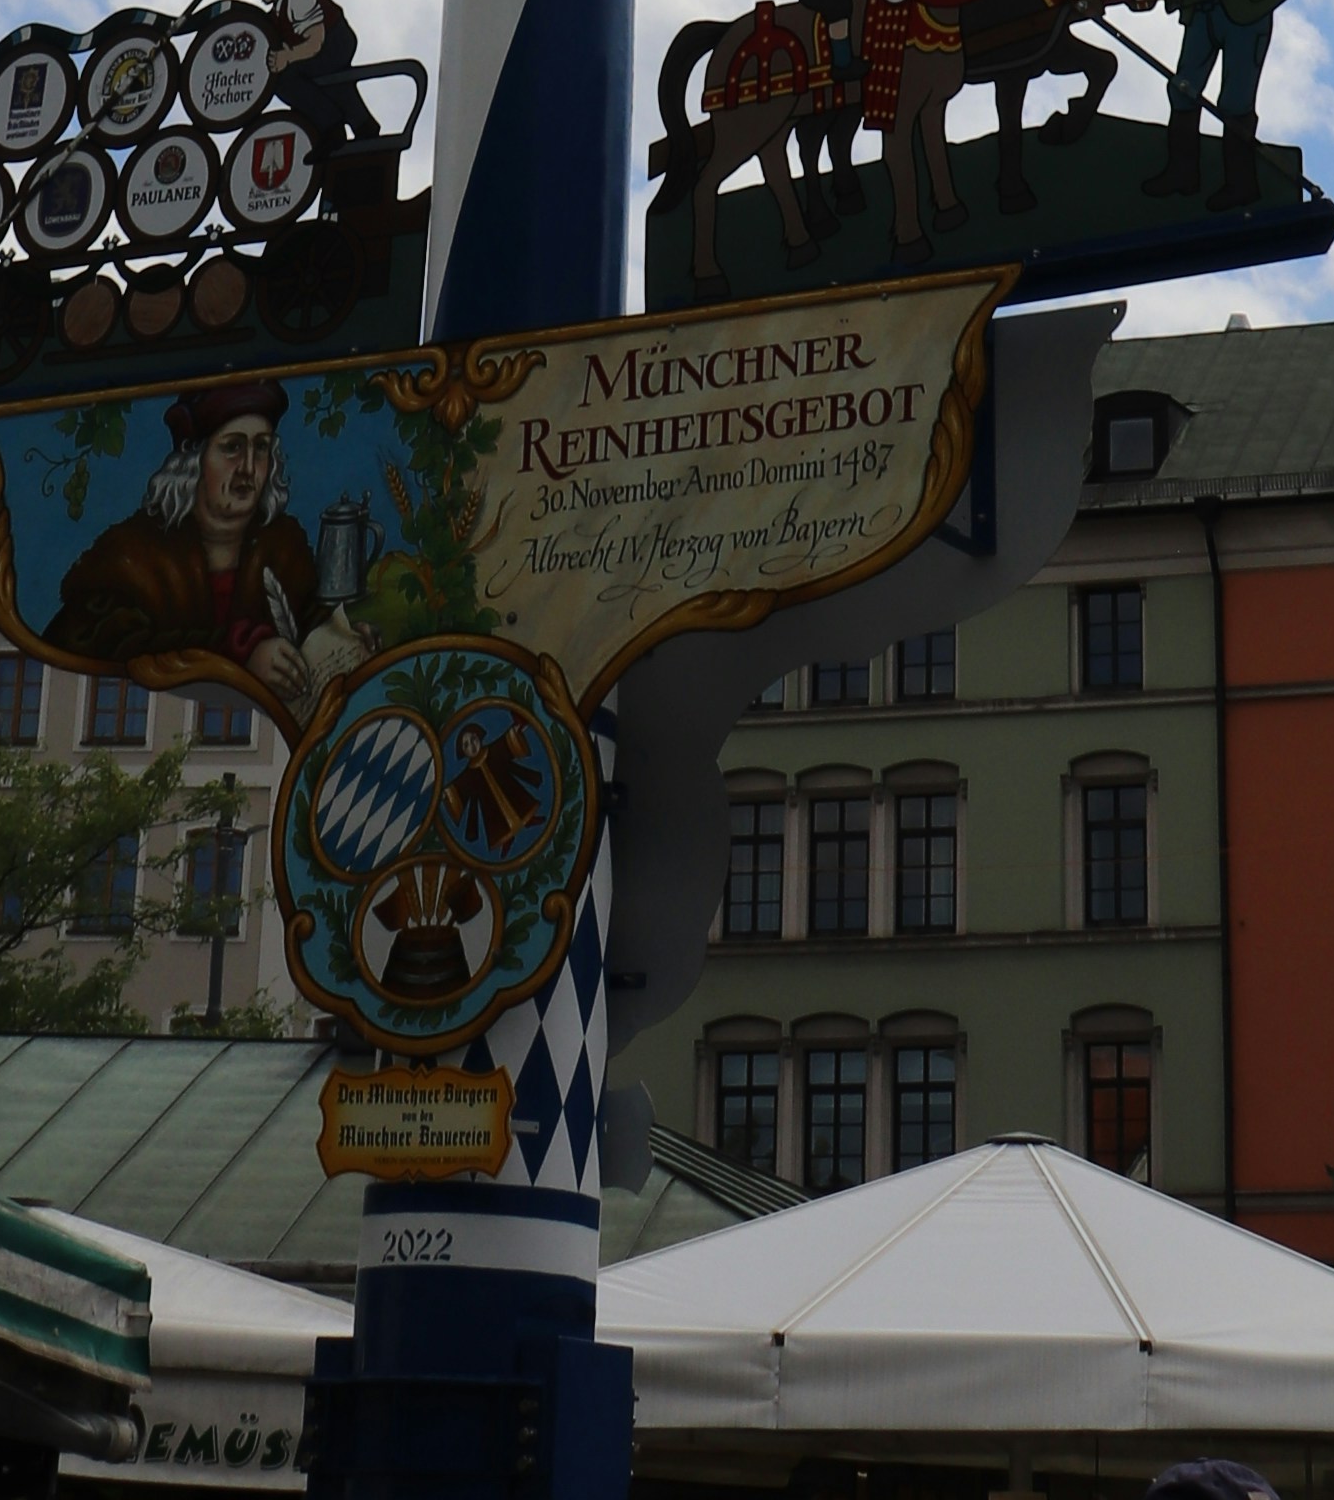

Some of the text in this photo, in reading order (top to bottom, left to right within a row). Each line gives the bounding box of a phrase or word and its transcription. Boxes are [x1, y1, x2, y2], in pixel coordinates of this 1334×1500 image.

[205, 69, 255, 89] Hacker
[202, 87, 253, 110] Pschorr
[131, 185, 202, 207] PAULANER
[247, 195, 291, 212] SPATEN
[517, 383, 926, 481] REINHEITSGEBOT
[683, 462, 745, 497] Anno
[744, 447, 827, 488] Domini
[832, 439, 896, 492] 1487
[501, 513, 616, 587] Albrecht
[641, 520, 727, 583] Herzog
[732, 526, 772, 551] von
[773, 490, 880, 571] Bayern
[337, 1082, 499, 1107] Den Münchner Bürgern
[337, 1124, 492, 1150] Münchner Brauereien
[380, 1227, 455, 1266] 2022
[135, 1412, 302, 1471] EMÜS
